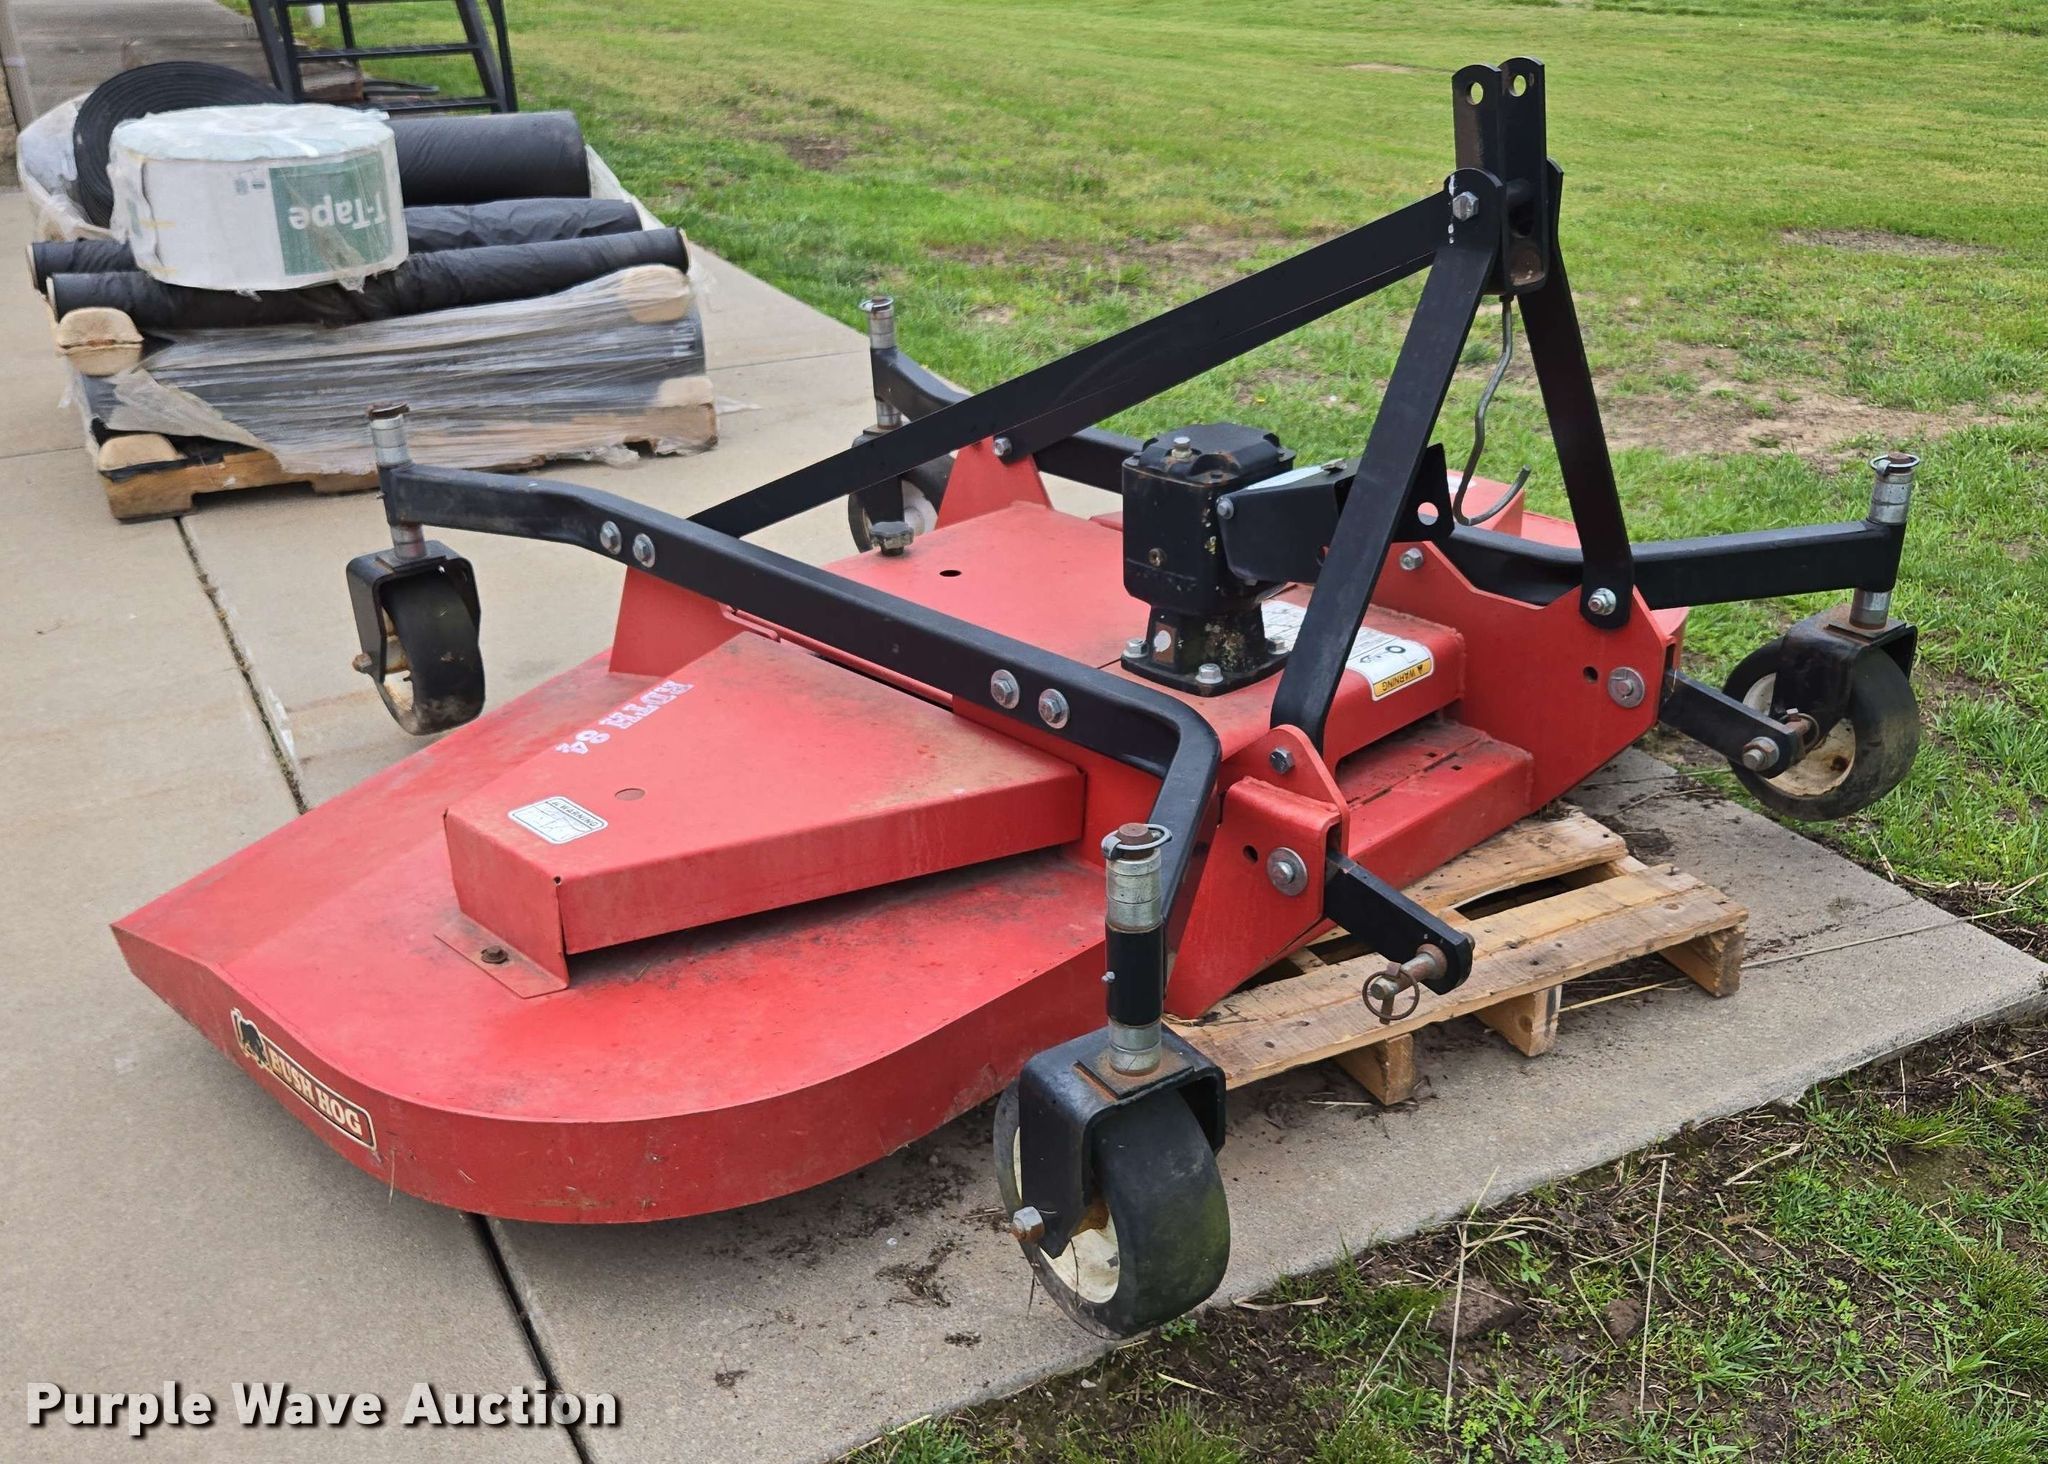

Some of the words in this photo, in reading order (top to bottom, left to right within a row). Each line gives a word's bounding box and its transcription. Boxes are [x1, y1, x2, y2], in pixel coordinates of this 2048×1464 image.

[288, 191, 387, 231] T-Tape
[1381, 669, 1418, 692] WARNING
[554, 728, 611, 755] 84
[560, 803, 599, 829] WARNING
[267, 1046, 315, 1104] BUSH
[316, 1090, 363, 1137] HOG
